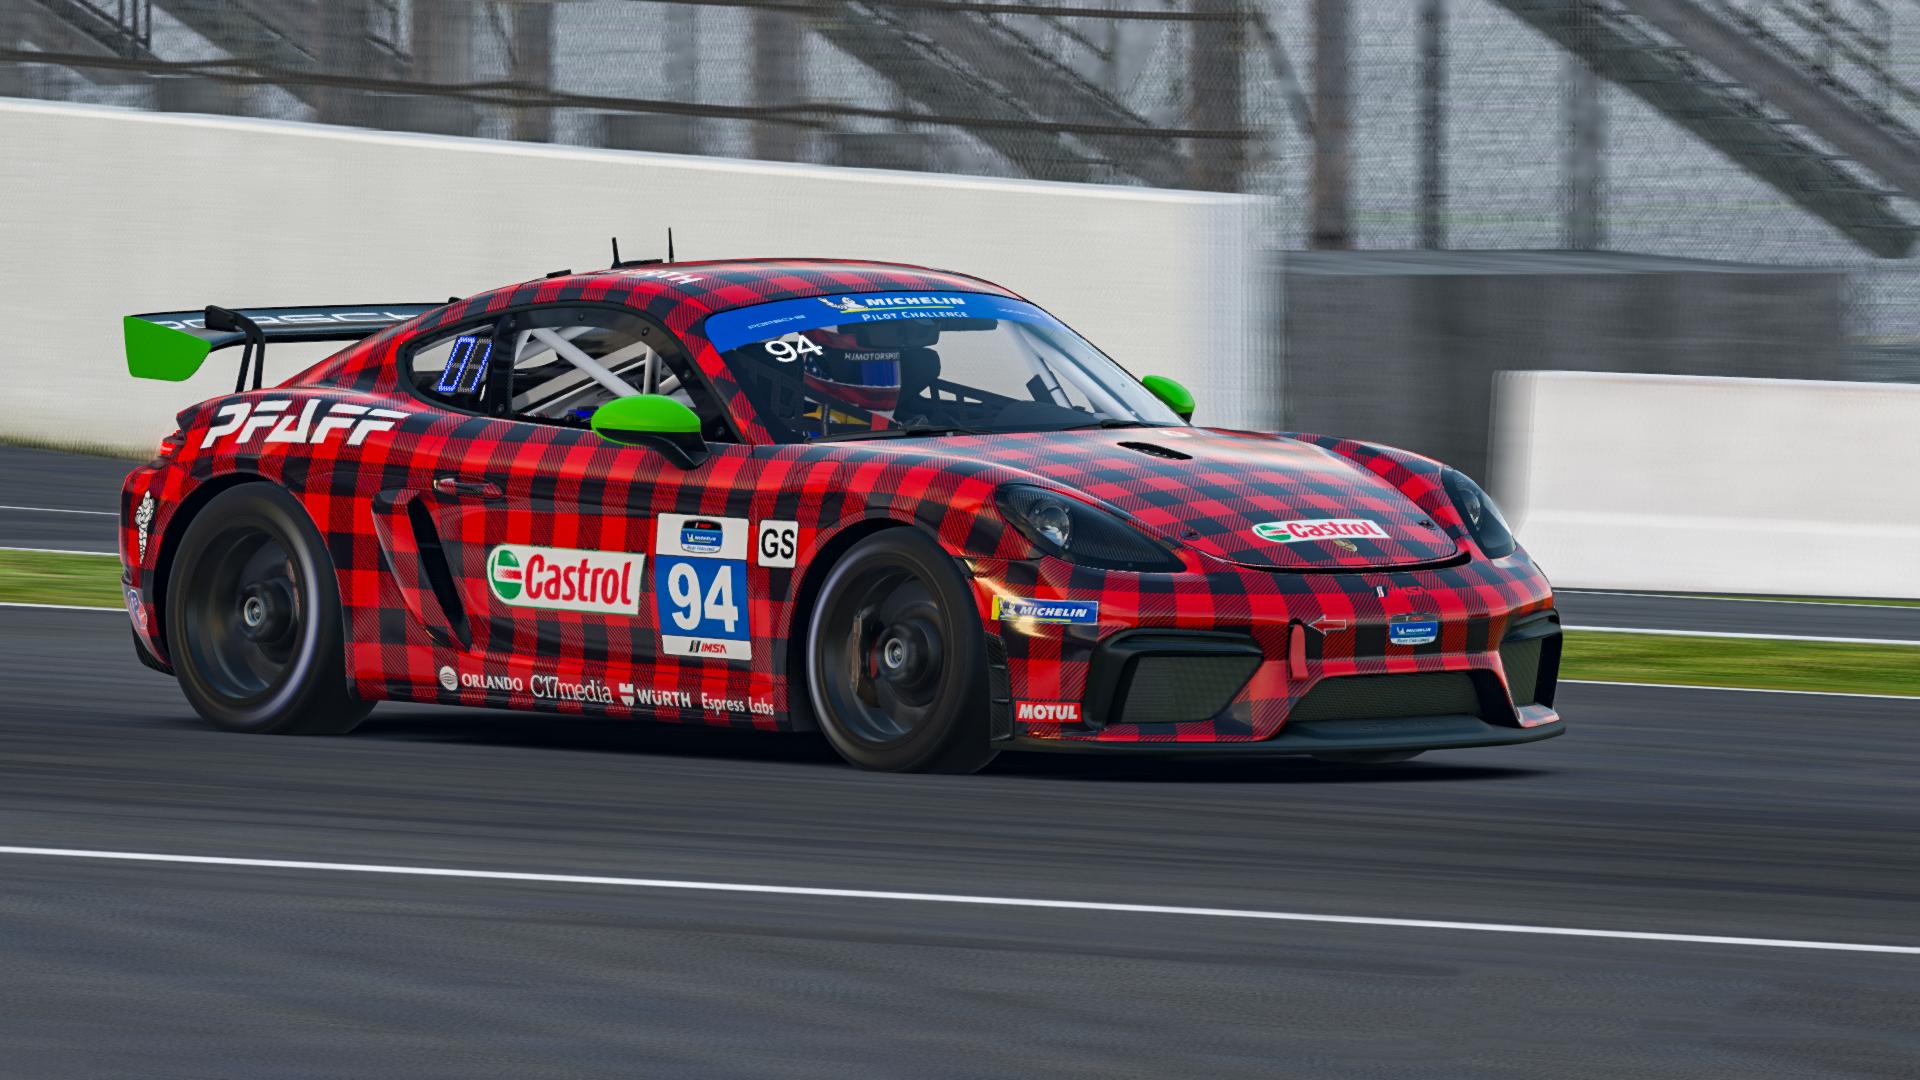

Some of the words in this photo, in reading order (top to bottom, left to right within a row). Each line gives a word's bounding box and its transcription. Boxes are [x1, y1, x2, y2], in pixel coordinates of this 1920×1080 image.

[865, 296, 966, 306] MICHELIN
[861, 313, 897, 322] PILOT
[902, 311, 969, 319] CHALLENGE
[764, 334, 824, 362] 94
[200, 399, 412, 449] PFAFF
[1286, 521, 1380, 538] Castrol
[761, 528, 795, 559] GS
[525, 553, 632, 606] Castrol
[667, 562, 739, 633] 94
[1020, 606, 1088, 618] MICHELIN
[701, 642, 727, 654] IMSA
[461, 673, 523, 692] ORLANDO
[530, 674, 614, 704] C17media
[636, 688, 692, 708] WÜRTH
[748, 696, 775, 716] Labs
[1018, 703, 1078, 720] MOTUL
